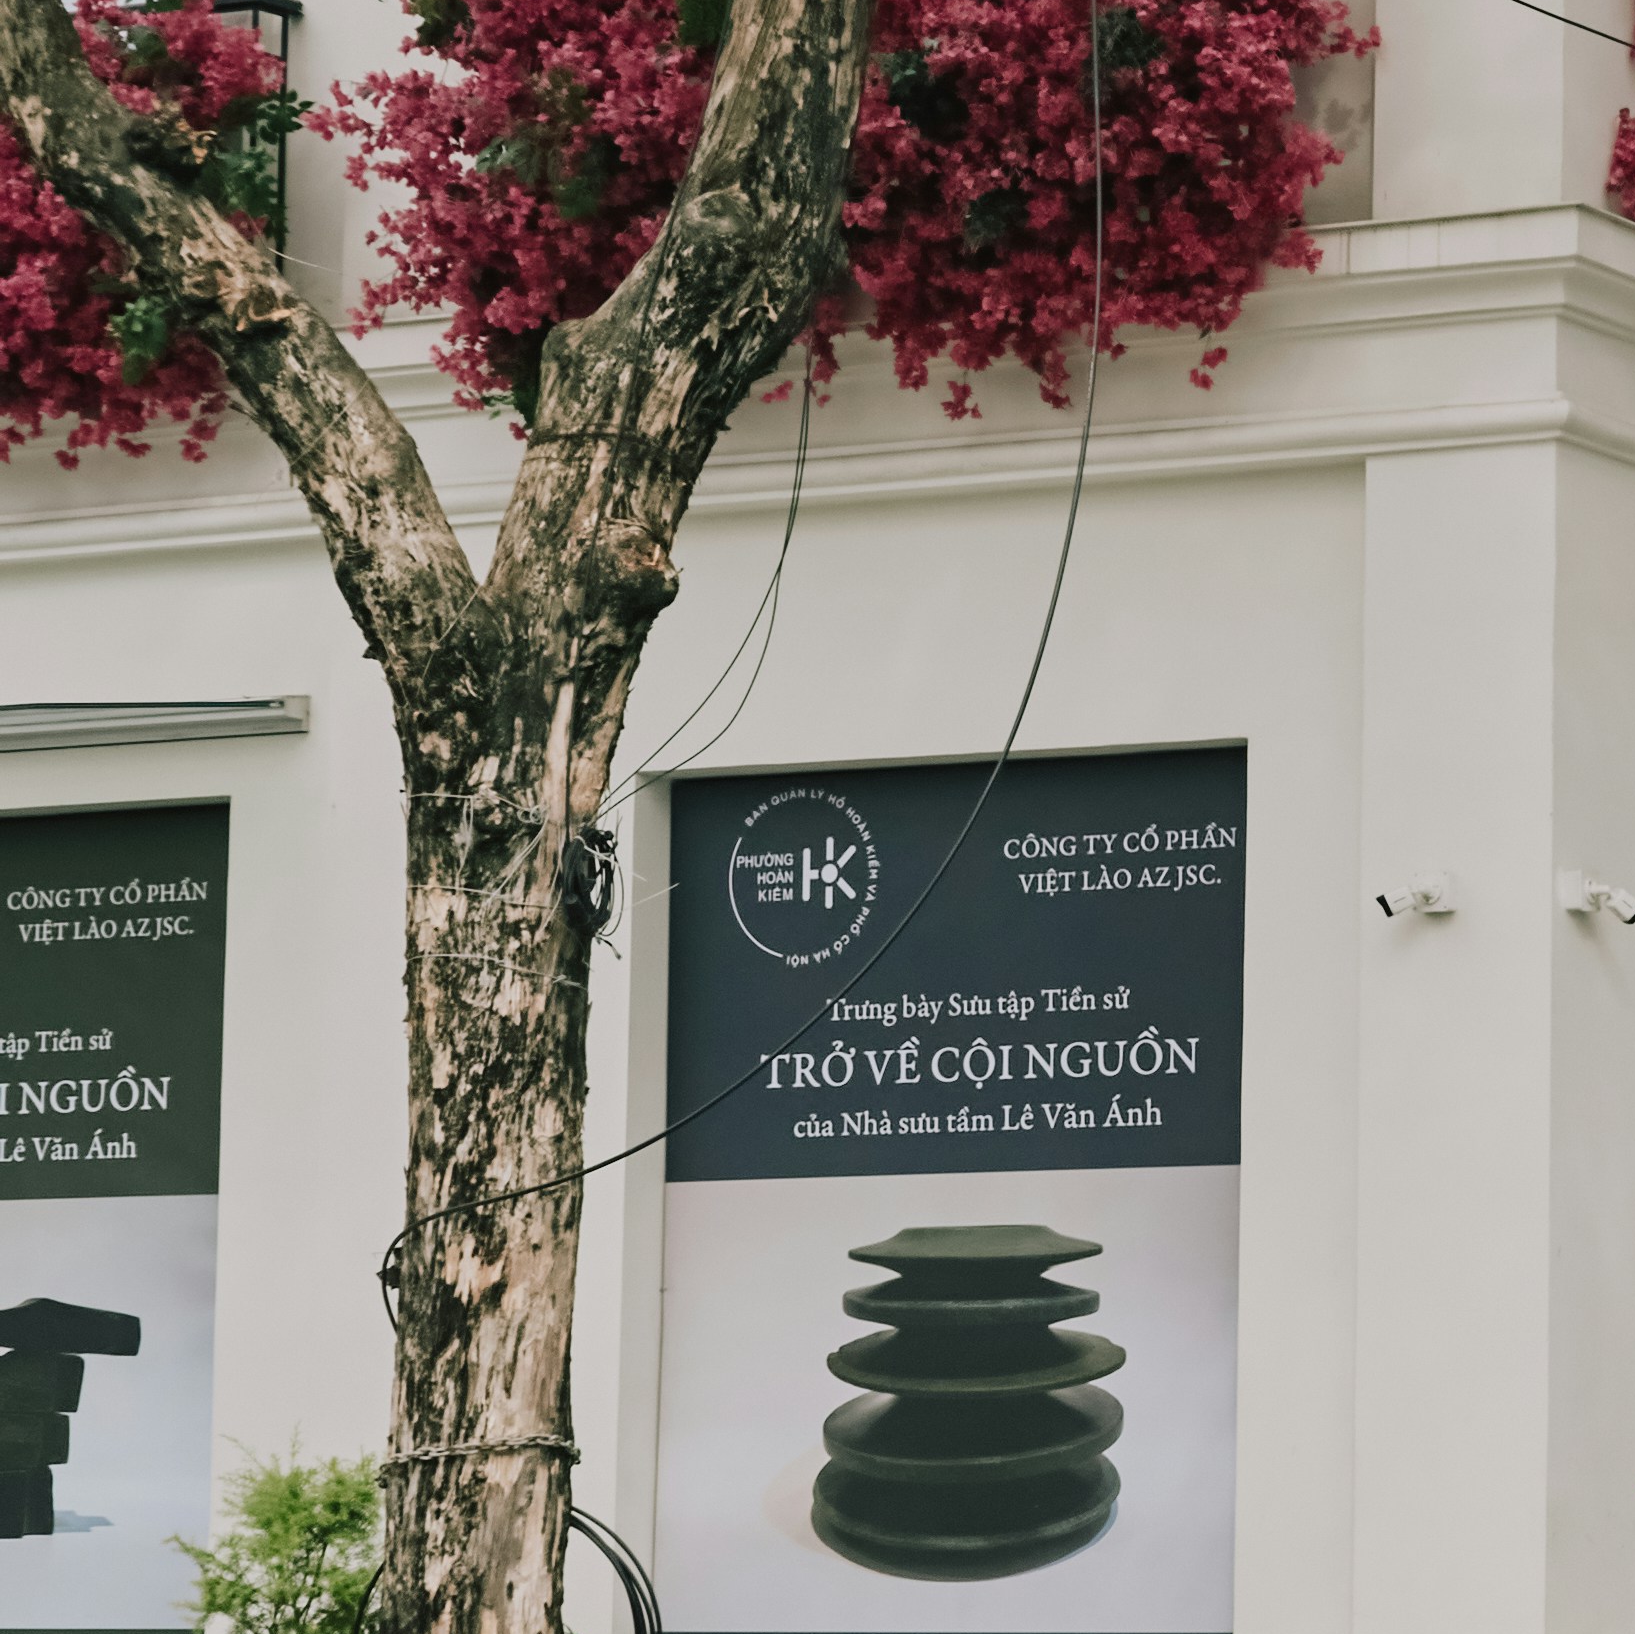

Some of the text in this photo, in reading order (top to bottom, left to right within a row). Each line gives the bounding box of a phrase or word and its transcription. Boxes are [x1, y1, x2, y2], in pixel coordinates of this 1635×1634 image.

[1004, 822, 1236, 859] CÔNG TY CỔ PHẦN
[737, 853, 793, 868] PHƯỜNG
[757, 869, 793, 884] HOÀN
[7, 877, 207, 910] CÔNG TY CỔ PHẦN
[745, 803, 768, 826] BAN
[786, 955, 808, 967] NỘI
[758, 887, 793, 901] KIẾM
[1019, 864, 1221, 896] VIỆT LÀO AZ JSC.
[19, 916, 194, 945] VIỆT LÀO AZ JSC.
[826, 986, 1130, 1026] Trưng bày Sưu tập Tiền sử
[35, 1028, 83, 1052] Tiền
[89, 1028, 113, 1050] sử
[760, 1026, 1199, 1089] TRỞ VỀ CỘI NGUỒN
[18, 1066, 170, 1114] NGUỒN
[794, 1094, 1162, 1138] của Nhà sưu tầm Lê Văn Ánh
[0, 1129, 137, 1162] Lê Văn Ánh
